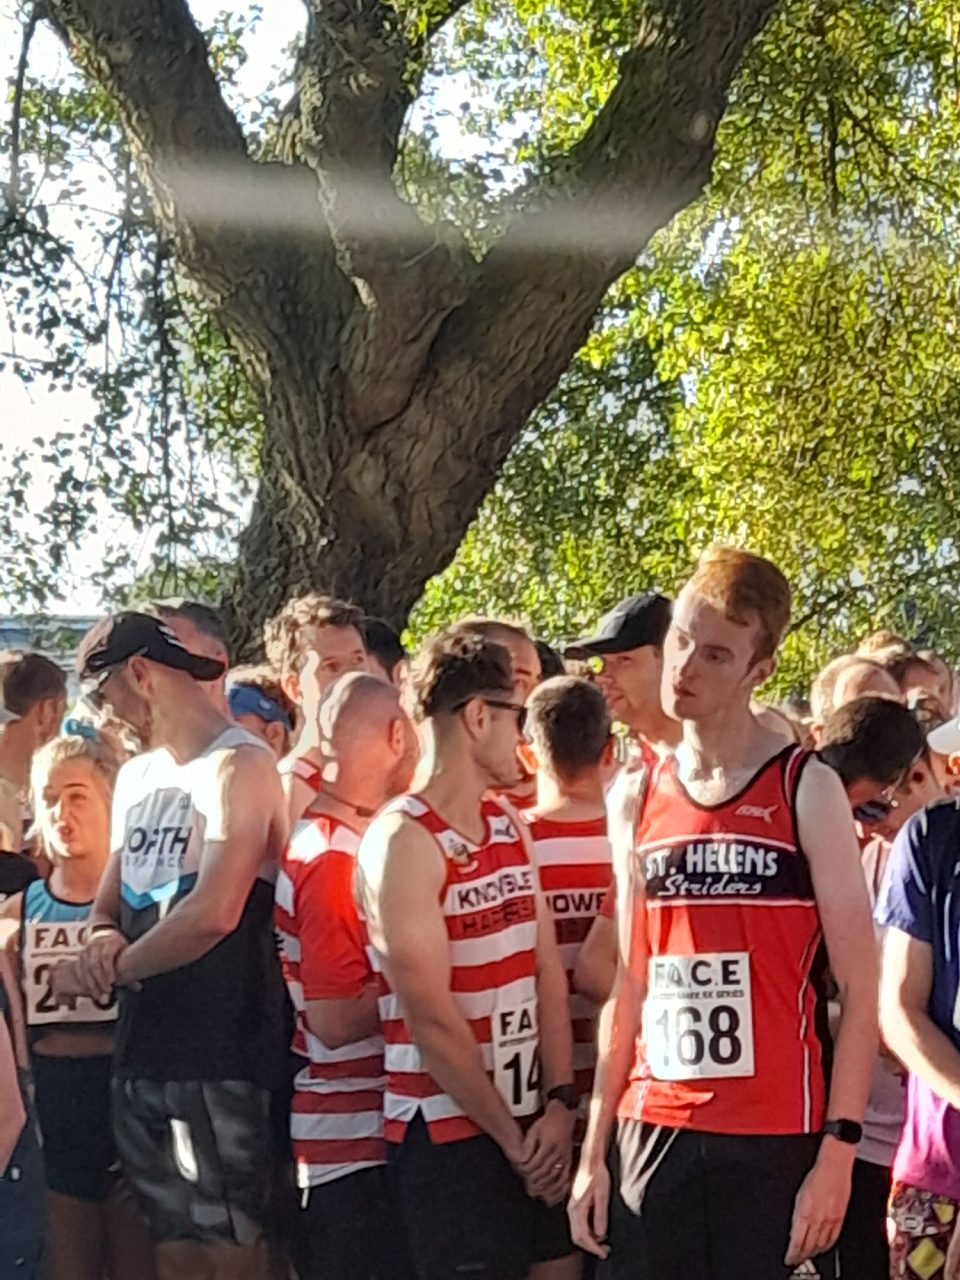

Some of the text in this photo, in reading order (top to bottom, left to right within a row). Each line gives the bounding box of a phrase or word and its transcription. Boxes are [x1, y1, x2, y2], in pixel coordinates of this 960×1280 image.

[646, 841, 778, 881] ST. HELENS
[657, 874, 762, 896] Striders
[655, 1004, 742, 1067] 168
